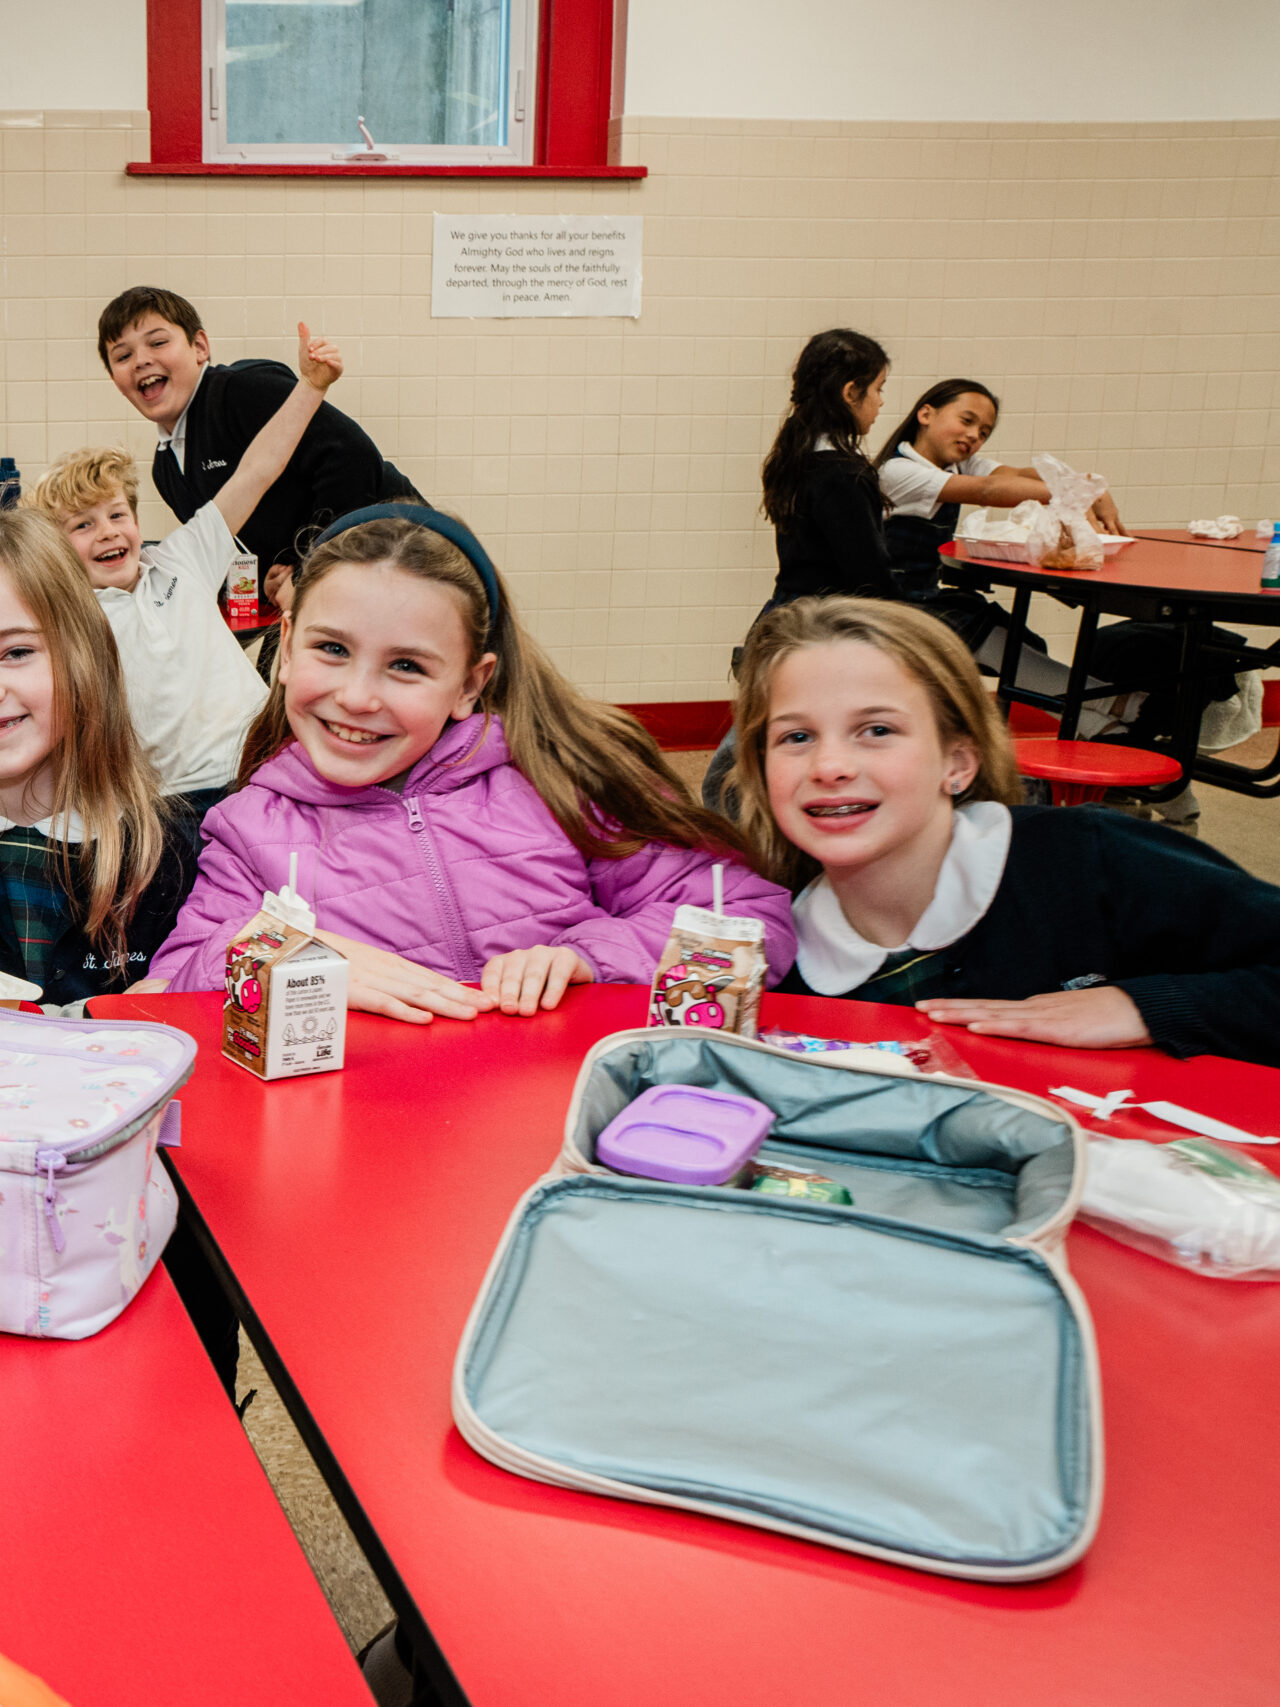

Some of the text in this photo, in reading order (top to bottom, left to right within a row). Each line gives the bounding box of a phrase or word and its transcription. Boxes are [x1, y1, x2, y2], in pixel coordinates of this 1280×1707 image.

[450, 231, 626, 242] We give you thanks for all your benefits
[461, 247, 614, 259] Almighty God who lives and reigns
[454, 263, 620, 275] forever. May the souls of the faithfully
[446, 278, 489, 289] departed,
[492, 278, 527, 289] through
[530, 278, 544, 287] the
[547, 280, 572, 289] mercy
[576, 278, 585, 287] of
[611, 279, 627, 287] rest
[503, 293, 571, 303] in peace. Amen.
[102, 950, 147, 969] Jaes
[287, 975, 326, 988] About 85%
